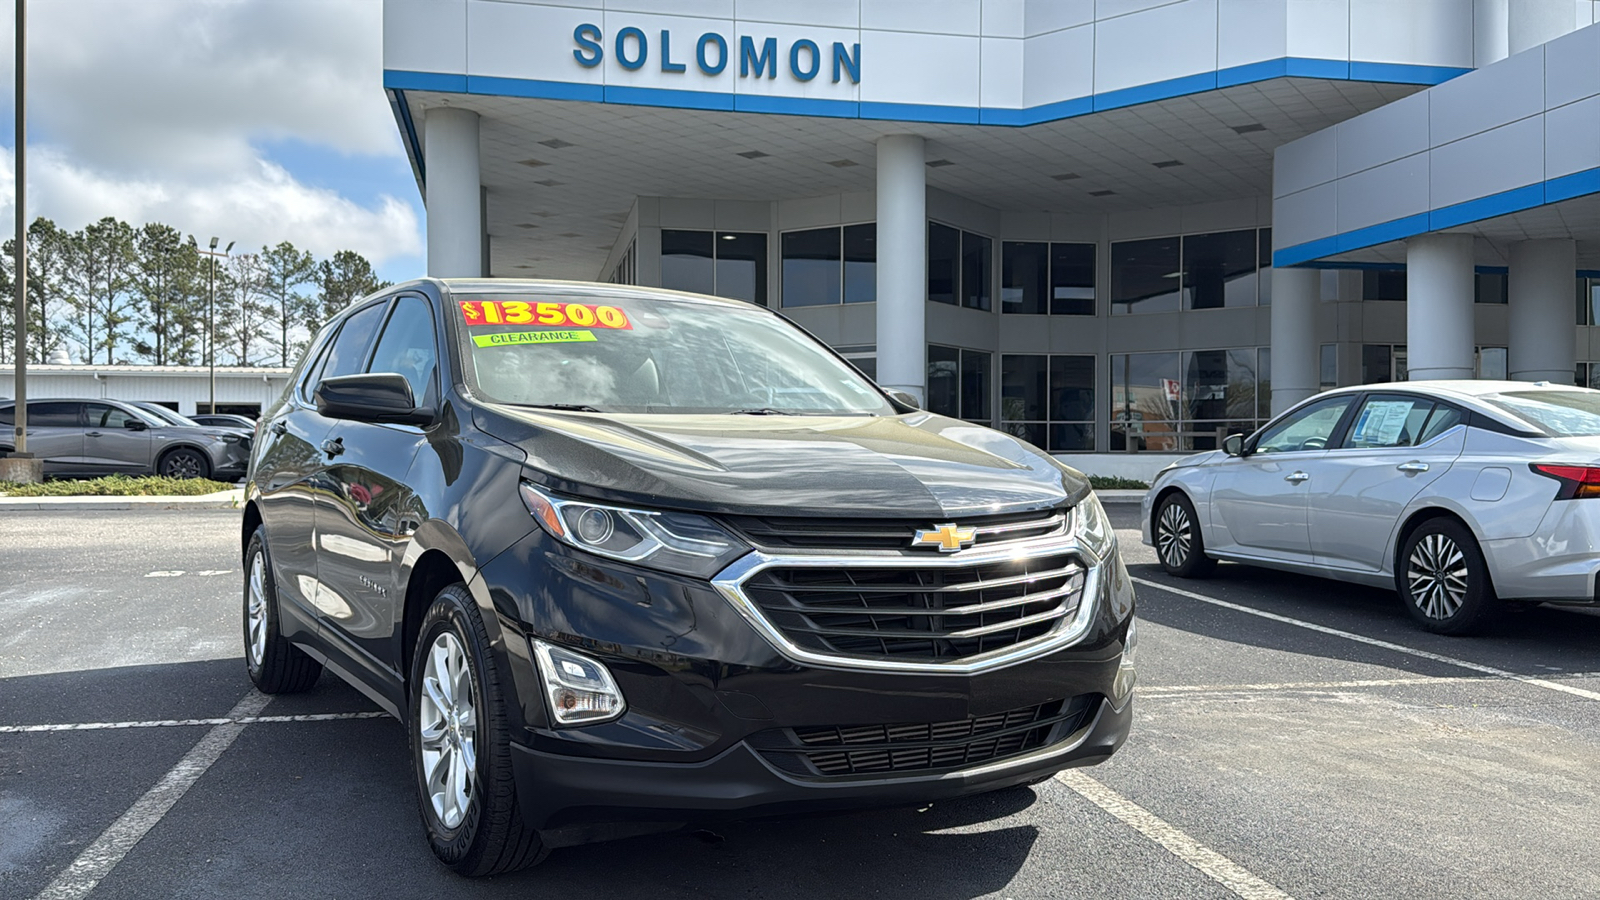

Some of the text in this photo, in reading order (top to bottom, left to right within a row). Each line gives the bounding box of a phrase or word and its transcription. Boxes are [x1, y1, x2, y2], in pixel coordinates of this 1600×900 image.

[573, 23, 861, 84] SOLOMON
[462, 301, 627, 328] $13500
[491, 331, 580, 344] CLEARANCE
